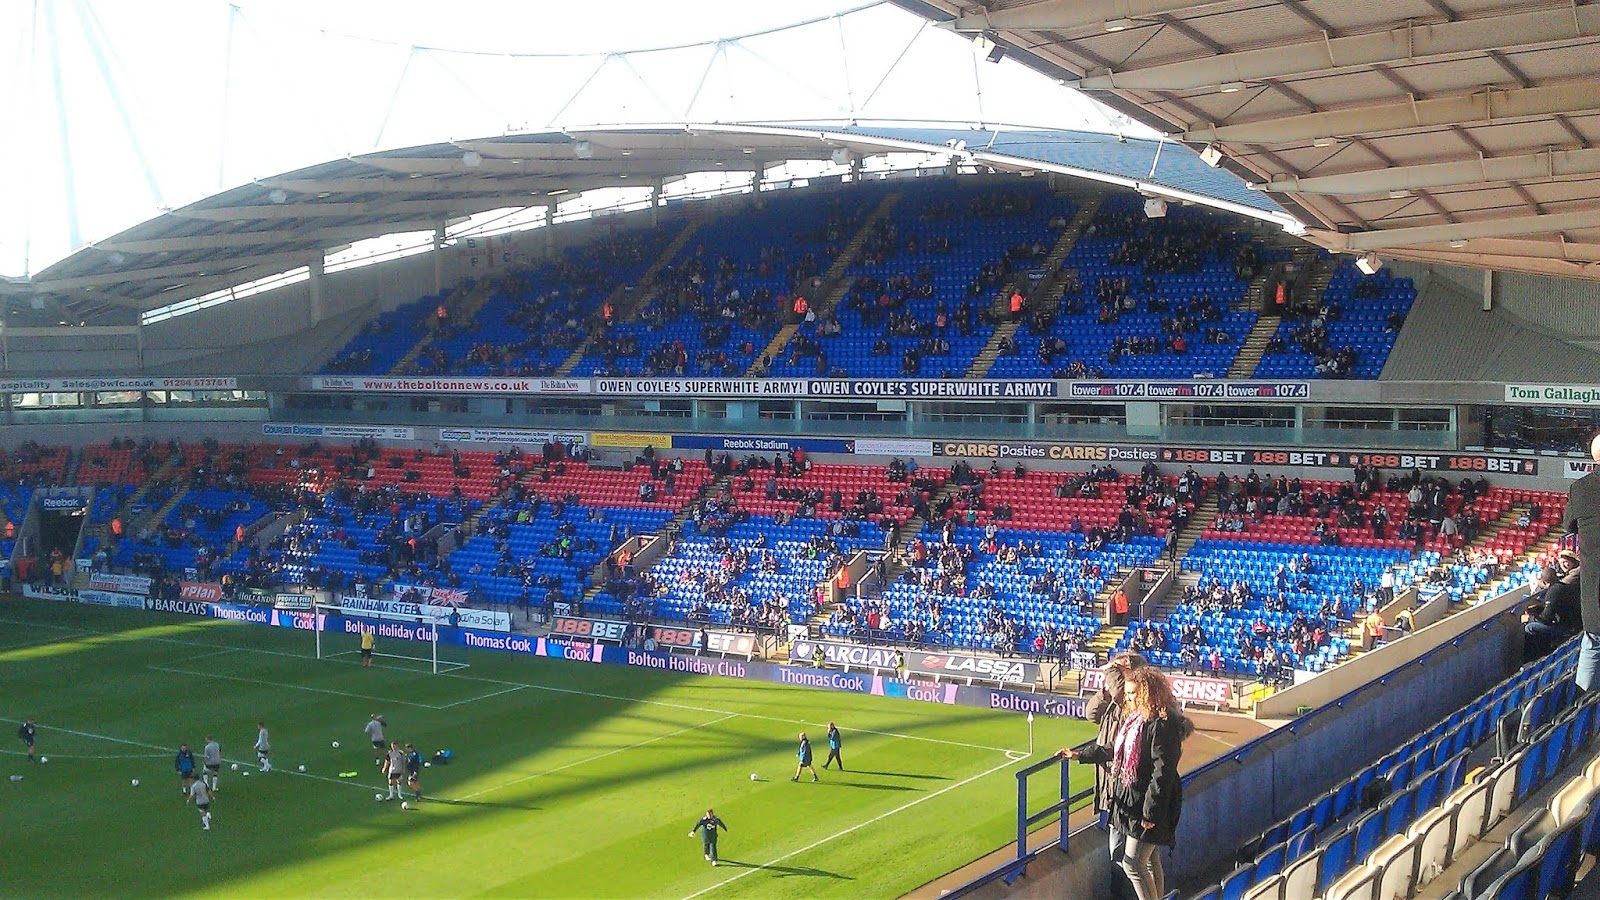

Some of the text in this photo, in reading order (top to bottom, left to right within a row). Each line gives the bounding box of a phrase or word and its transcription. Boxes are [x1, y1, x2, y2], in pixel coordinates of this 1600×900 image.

[364, 380, 530, 391] www.theboltonnews.co.uk
[600, 381, 803, 394] OWEN COYLE'S SUPERWHITE ARMY!
[812, 382, 1052, 396] OWEN COYLE'S SUPERWHITE ARMY!
[1114, 384, 1145, 396] 107.4
[1193, 385, 1224, 396] 107.4
[1274, 385, 1306, 397] 107.4
[1510, 387, 1600, 403] Tom Gallagh
[724, 438, 789, 450] Reebok Stadium
[945, 443, 998, 458] CARRS
[1000, 444, 1045, 459] Pasties
[1049, 445, 1157, 461] CARRS Pasties
[1175, 450, 1246, 463] 188BET
[1253, 452, 1327, 466] 188BET
[1363, 455, 1440, 469] 188BET
[1450, 457, 1522, 472] 188BET
[44, 499, 79, 507] Reebok
[155, 600, 207, 615] BARCLAYS
[213, 605, 267, 623] Thomas Cook
[343, 598, 421, 615] RAINHAM STEE
[293, 617, 315, 631] Cook
[481, 614, 505, 626] Solar
[379, 624, 415, 641] Holiday
[465, 632, 531, 652] Thomas Cook
[564, 646, 591, 661] Cook
[812, 644, 906, 668] ARCLAY
[628, 651, 746, 677] Bolton Holiday Club
[944, 657, 1025, 676] LASSA
[779, 668, 864, 691] Thomas Cook
[989, 672, 1024, 683] TYRES
[906, 685, 940, 703] Cook
[1173, 678, 1228, 701] SENSE
[990, 692, 1086, 718] Bolton olid
